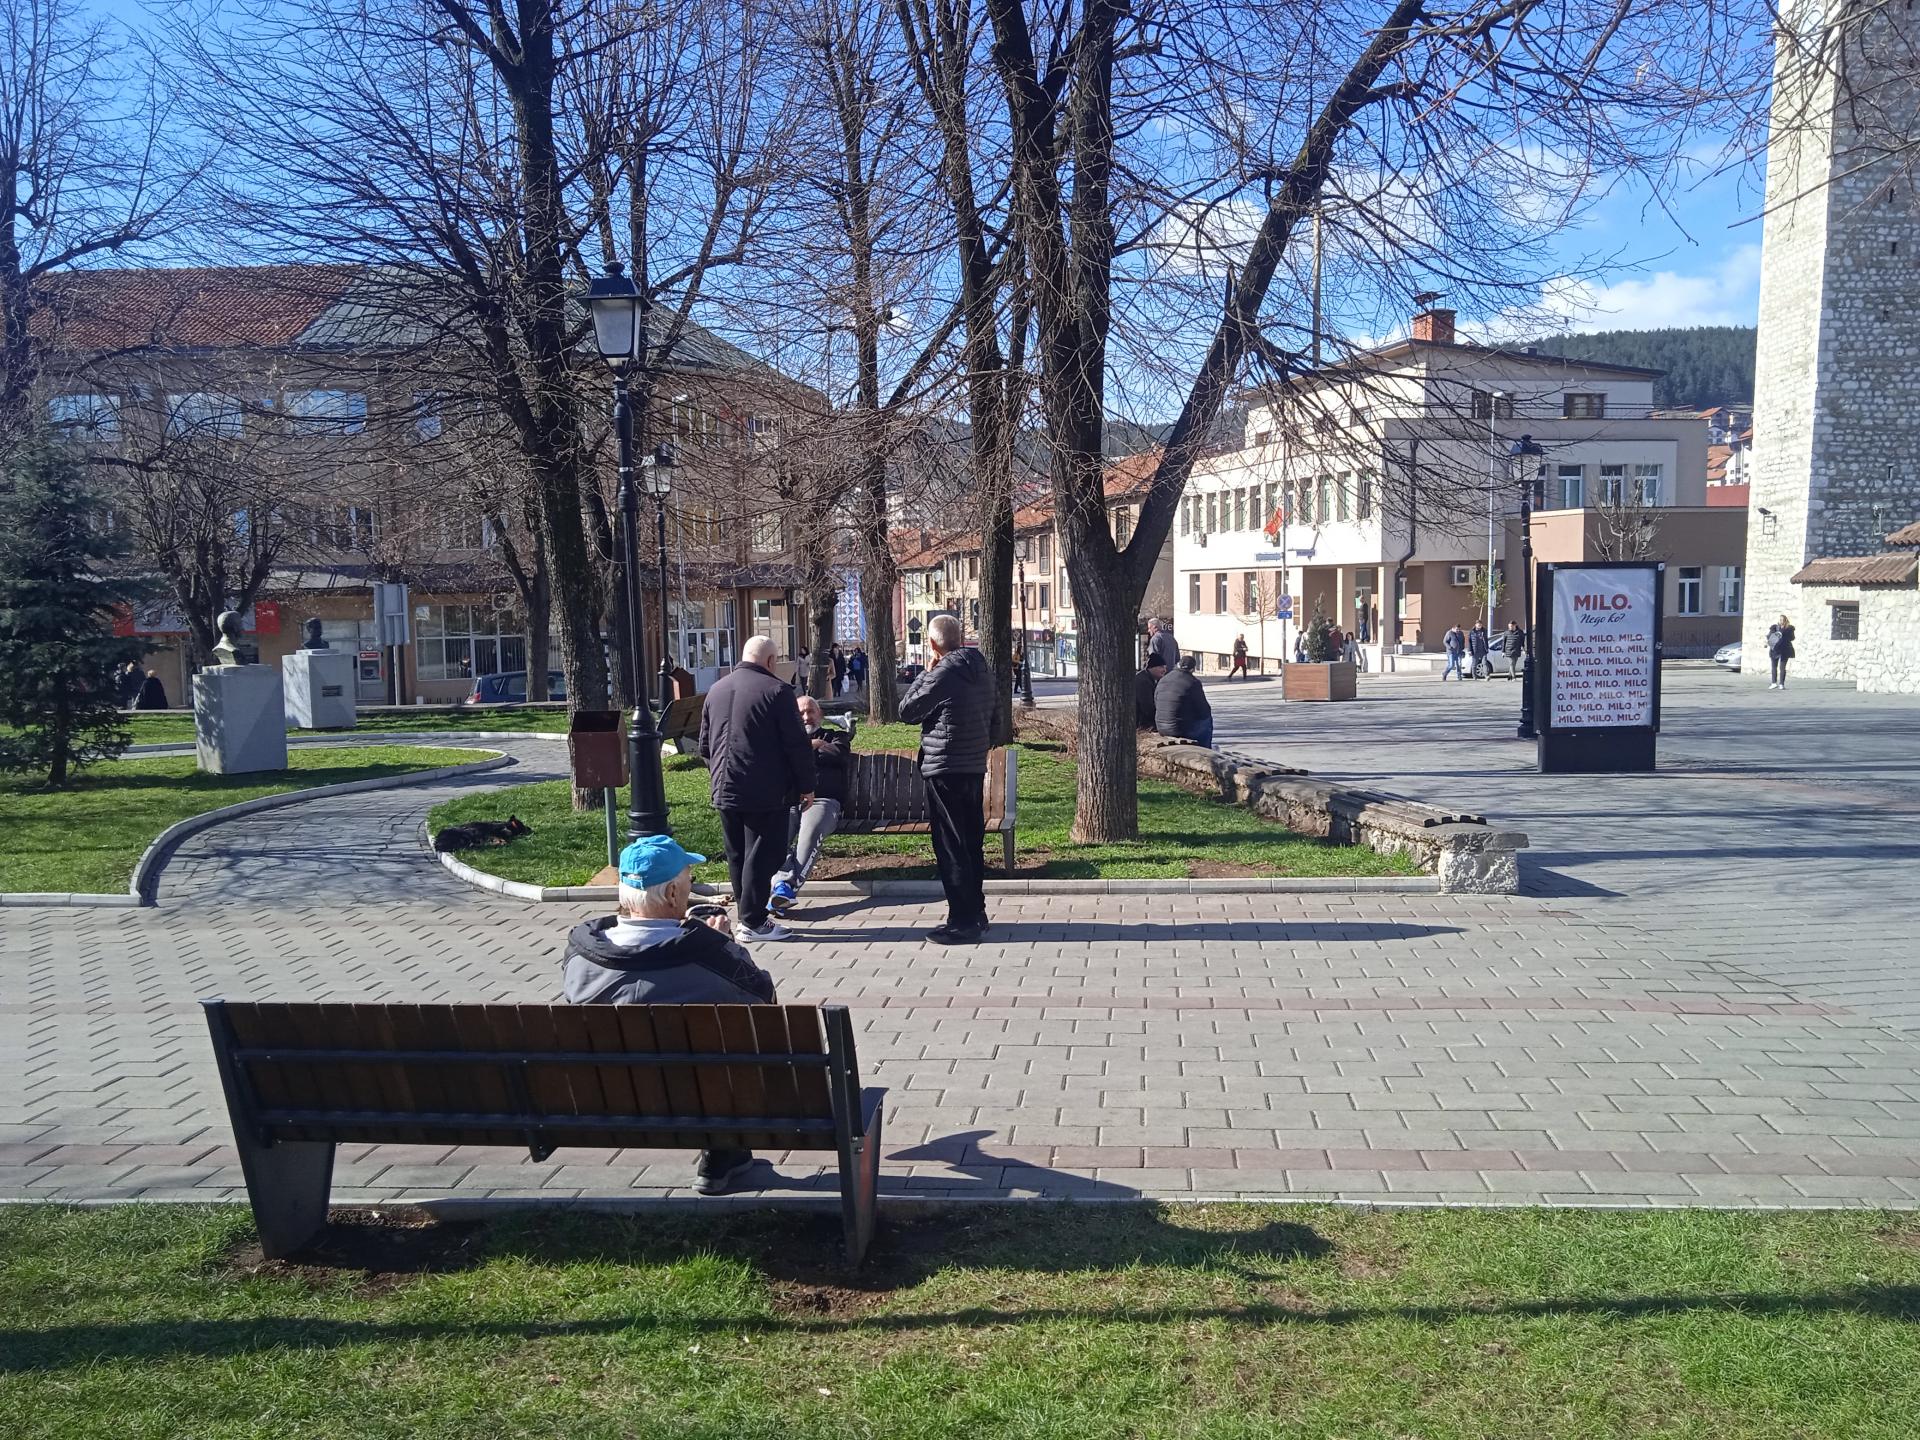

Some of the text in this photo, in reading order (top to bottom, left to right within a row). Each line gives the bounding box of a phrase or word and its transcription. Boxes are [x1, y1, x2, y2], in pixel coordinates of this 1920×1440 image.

[1574, 594, 1632, 611] MILO.
[1580, 612, 1626, 627] Nego ko?
[1598, 646, 1624, 654] MILO.
[1577, 658, 1603, 666] MILO.
[1557, 670, 1582, 678] MILO.
[1586, 669, 1612, 677] MILO.
[1615, 668, 1642, 676] MILO.
[1566, 681, 1591, 689] MILO.
[1595, 680, 1620, 688] MILO.
[1570, 692, 1595, 700] MILO.
[1599, 692, 1625, 700] MILO.
[1579, 704, 1604, 712] MILO.
[1558, 715, 1584, 723] MILO.
[1588, 714, 1613, 722] MILO.
